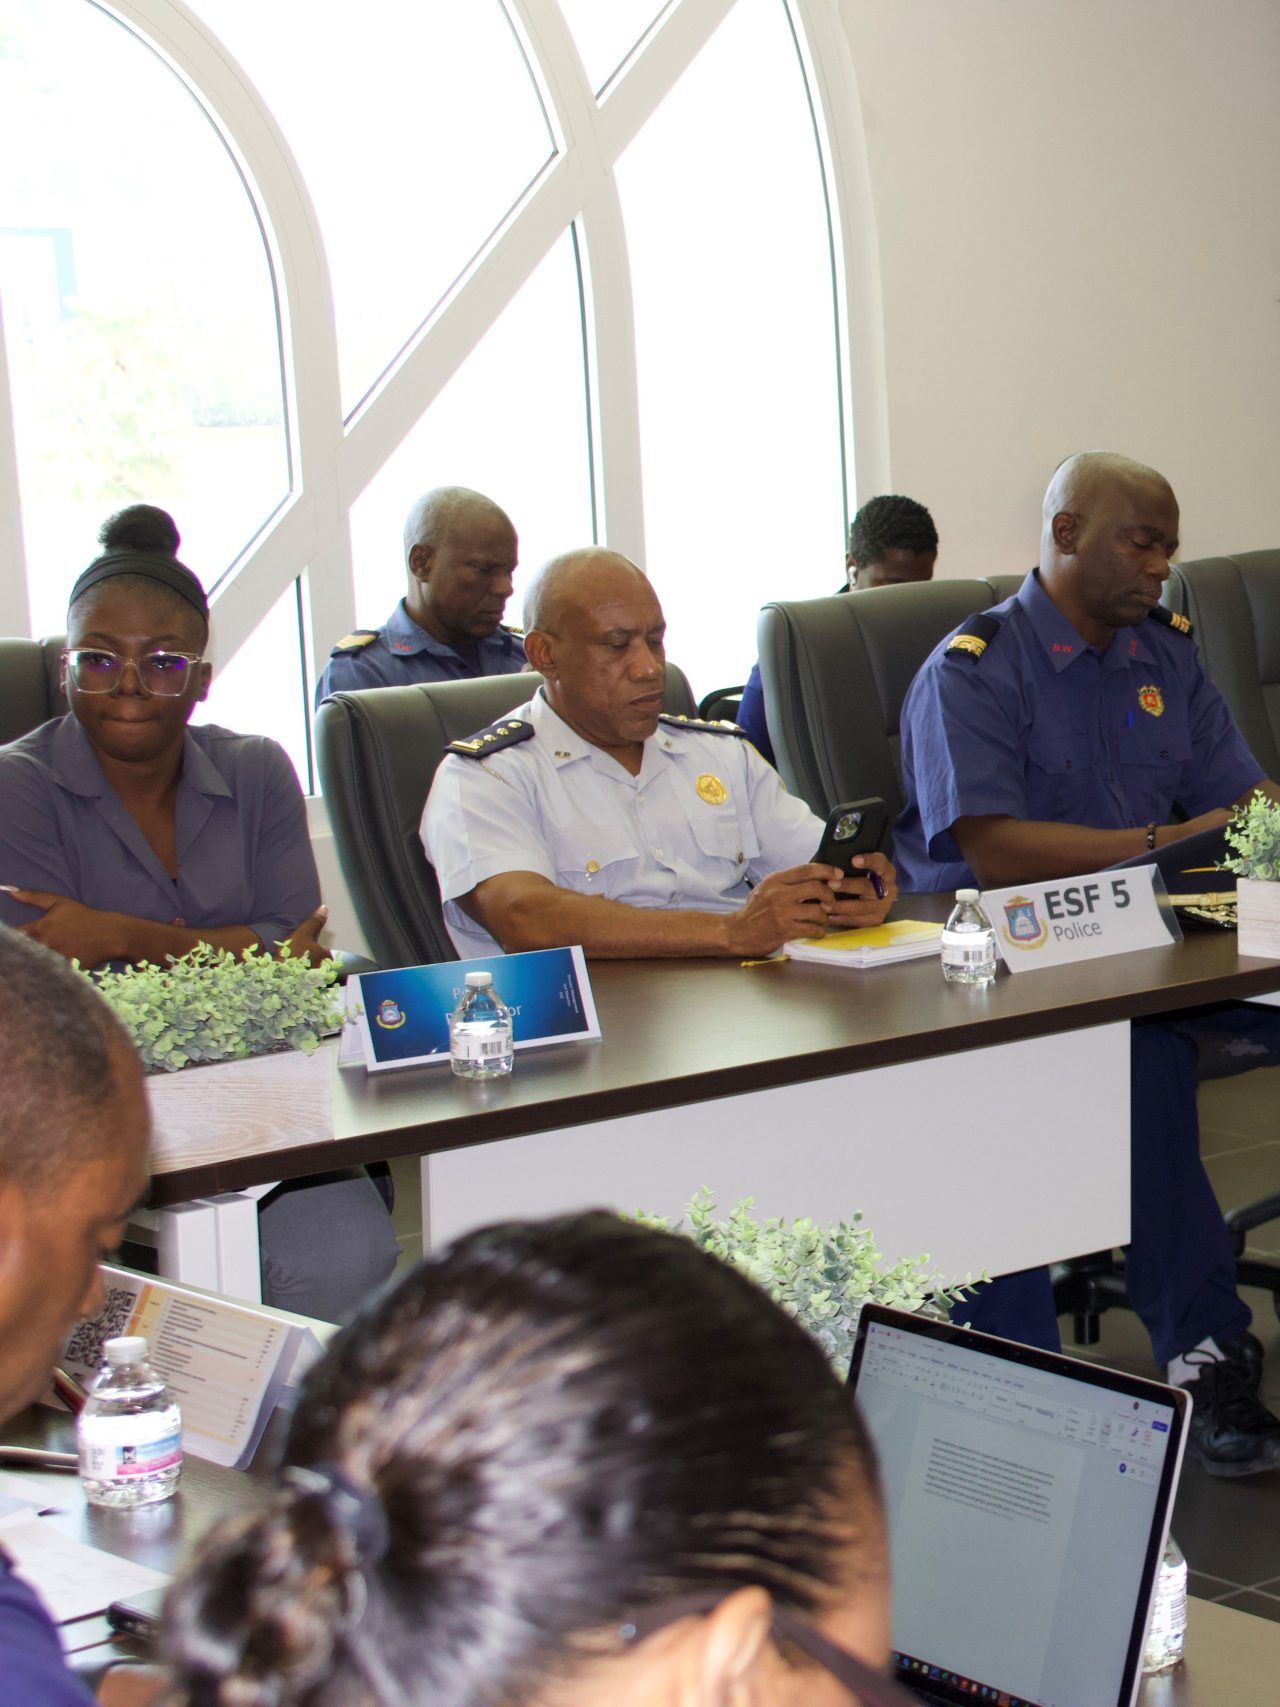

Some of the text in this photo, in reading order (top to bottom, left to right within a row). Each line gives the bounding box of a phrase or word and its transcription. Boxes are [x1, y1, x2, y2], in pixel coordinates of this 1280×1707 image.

[1044, 879, 1130, 920] ESF 5
[1053, 920, 1103, 943] Police
